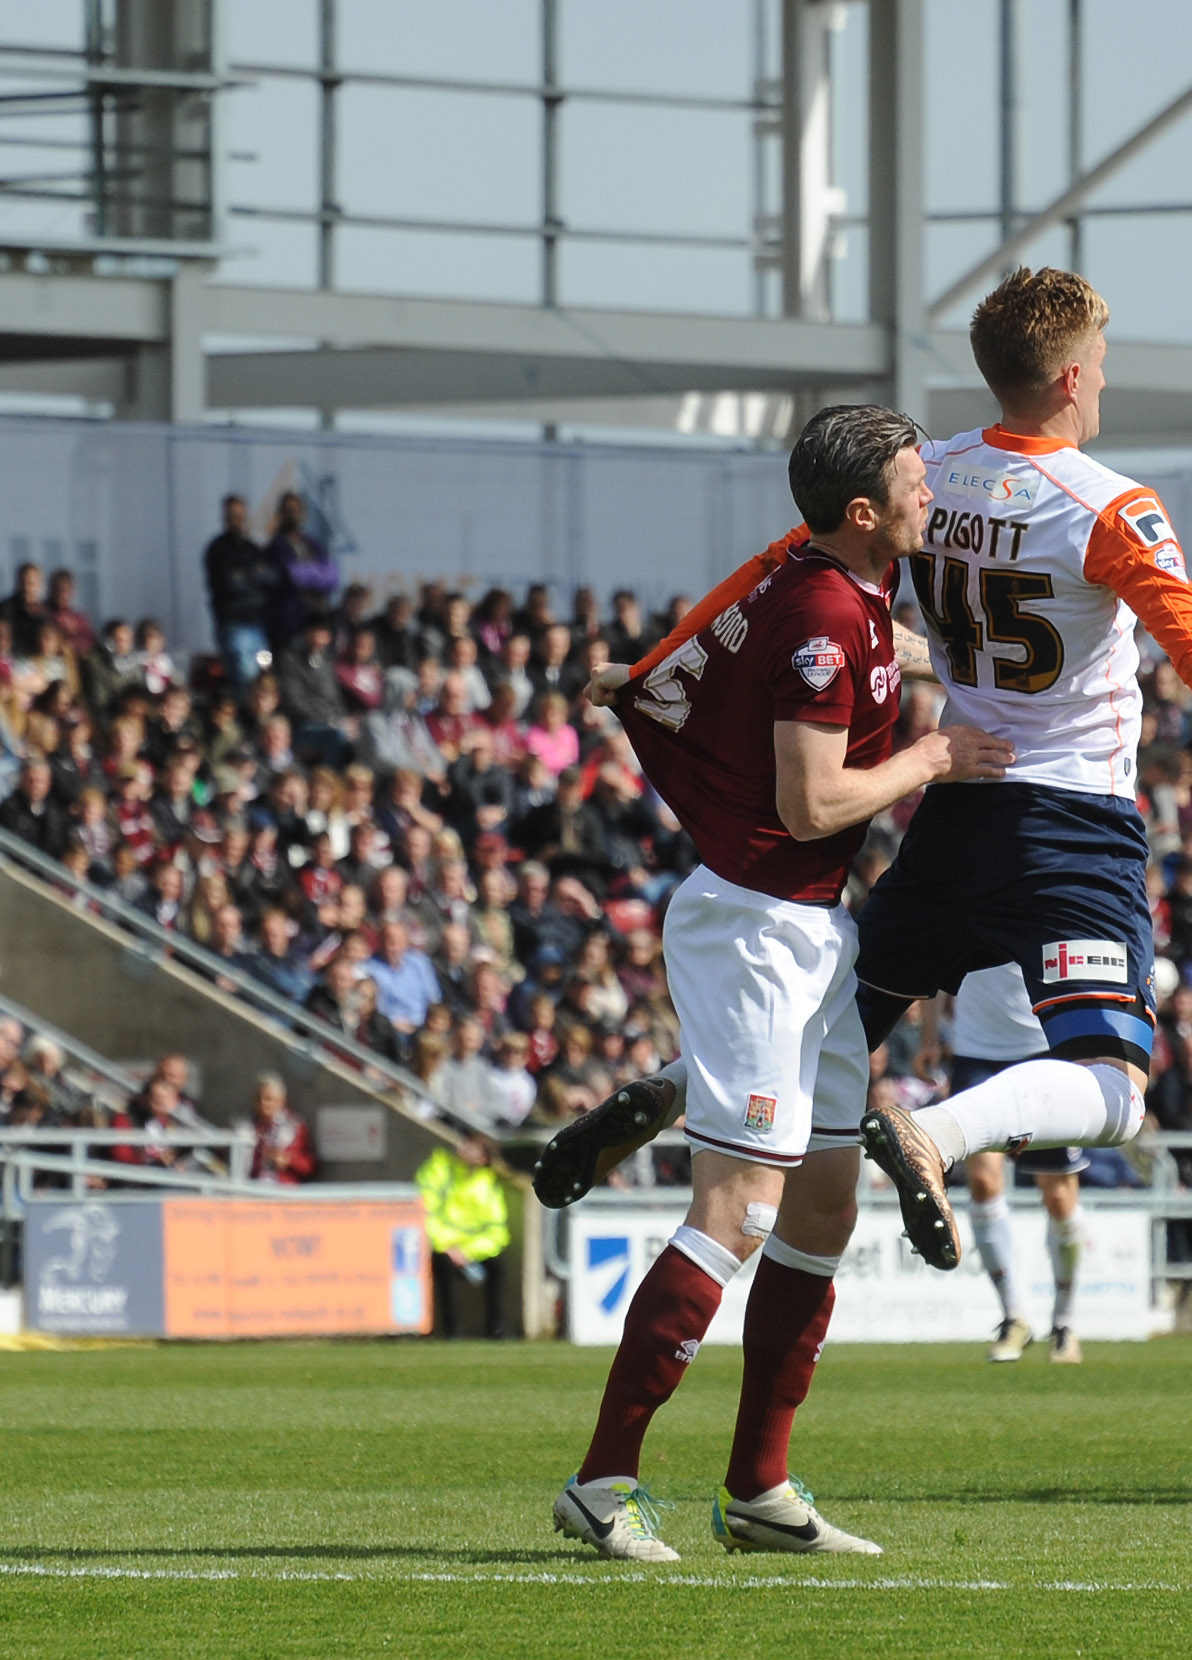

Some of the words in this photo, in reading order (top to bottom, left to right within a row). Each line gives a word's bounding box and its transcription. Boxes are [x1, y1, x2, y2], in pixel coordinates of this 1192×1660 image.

[948, 471, 1032, 500] ELECSA
[927, 507, 1029, 561] PIGOTT
[908, 551, 1064, 694] 45
[795, 655, 814, 667] sky
[818, 655, 841, 665] BET
